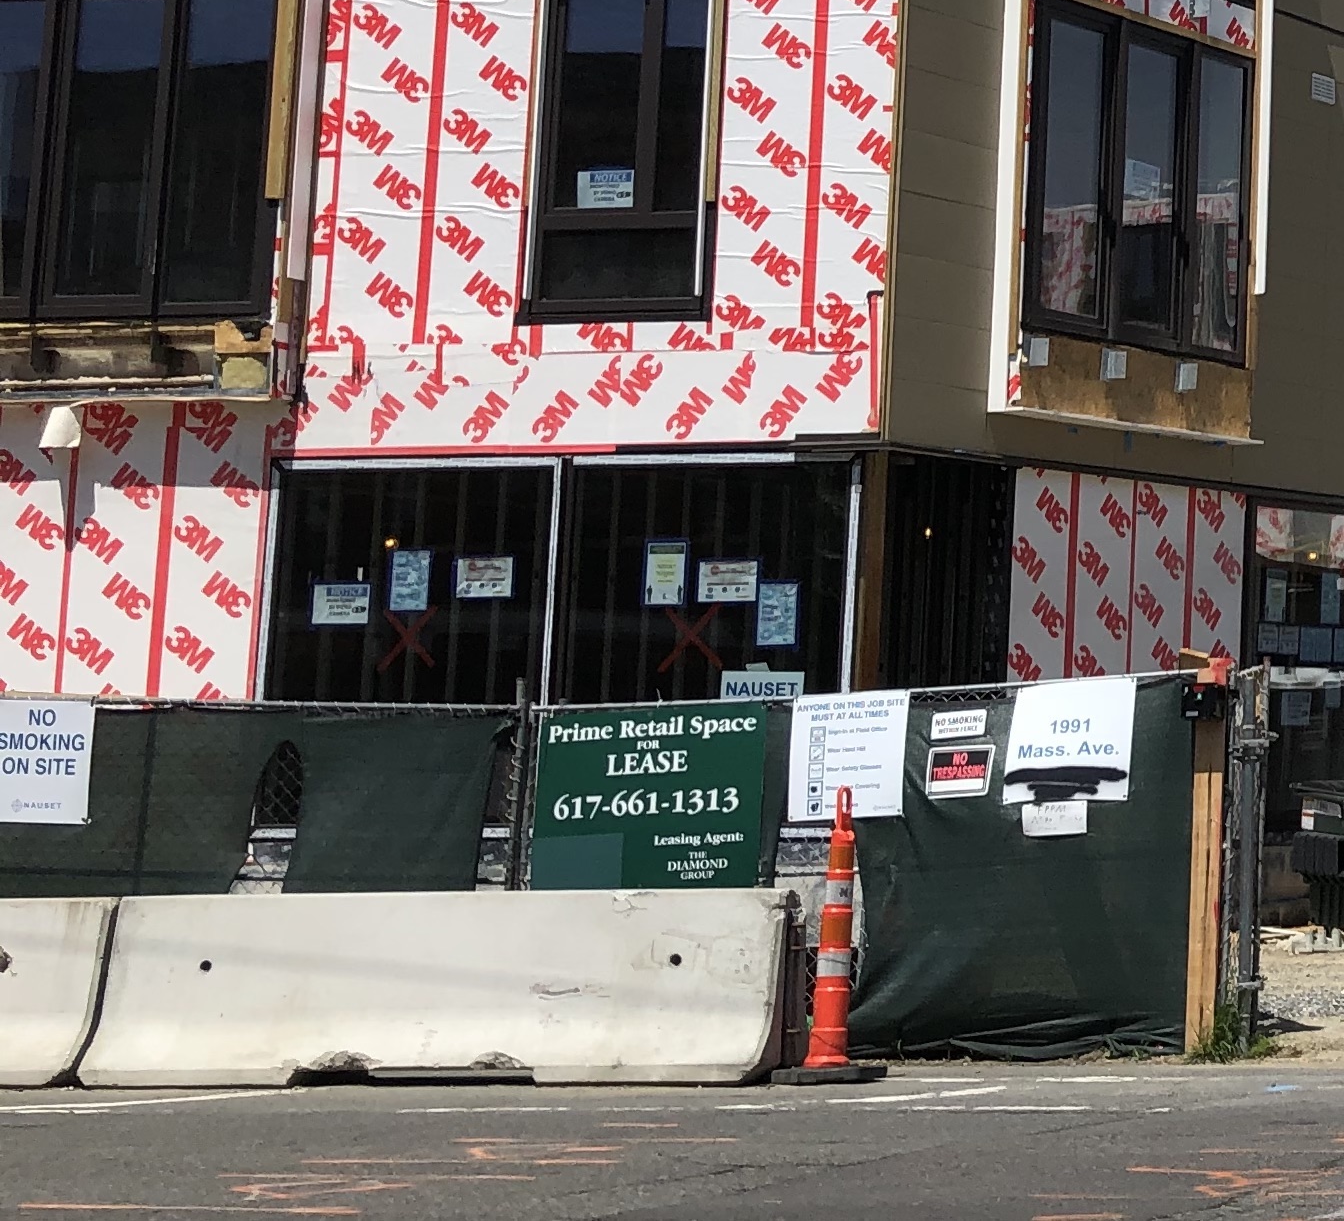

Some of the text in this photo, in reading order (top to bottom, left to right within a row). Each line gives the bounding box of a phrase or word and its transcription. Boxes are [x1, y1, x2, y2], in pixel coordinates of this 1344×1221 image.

[450, 2, 498, 47] 3M
[726, 77, 776, 122] 3M
[345, 111, 393, 154] 3M
[757, 132, 807, 177] 3M
[821, 183, 872, 229] 3M
[751, 240, 802, 287] 3M
[760, 385, 807, 439] 3M
[172, 515, 222, 561] 3M
[102, 573, 152, 620] 3M
[202, 572, 252, 618] 3M
[164, 626, 214, 673] 3M
[725, 681, 798, 697] NAUSET
[797, 698, 905, 713] ANYONE ON THIS JOB SITE
[29, 709, 57, 727] NO
[811, 709, 890, 722] MUST AT ALL TIMES
[935, 715, 984, 727] NO SMOKING
[548, 715, 757, 744] Prime Retail Space
[1050, 718, 1091, 734] 1991
[0, 732, 85, 751] SMOKING
[637, 740, 660, 751] FOR
[1017, 741, 1120, 759] Mass. Ave.
[2, 756, 77, 776] ON SITE
[606, 750, 688, 776] LEASE
[953, 752, 968, 765] NO
[933, 764, 986, 780] TRESPASSING
[23, 802, 62, 810] NAUSET
[553, 787, 740, 821] 617-661-1313
[654, 832, 744, 847] Leasing Agent:
[688, 851, 707, 859] THE
[667, 858, 728, 872] DIAMOND
[680, 870, 715, 880] GROUP
